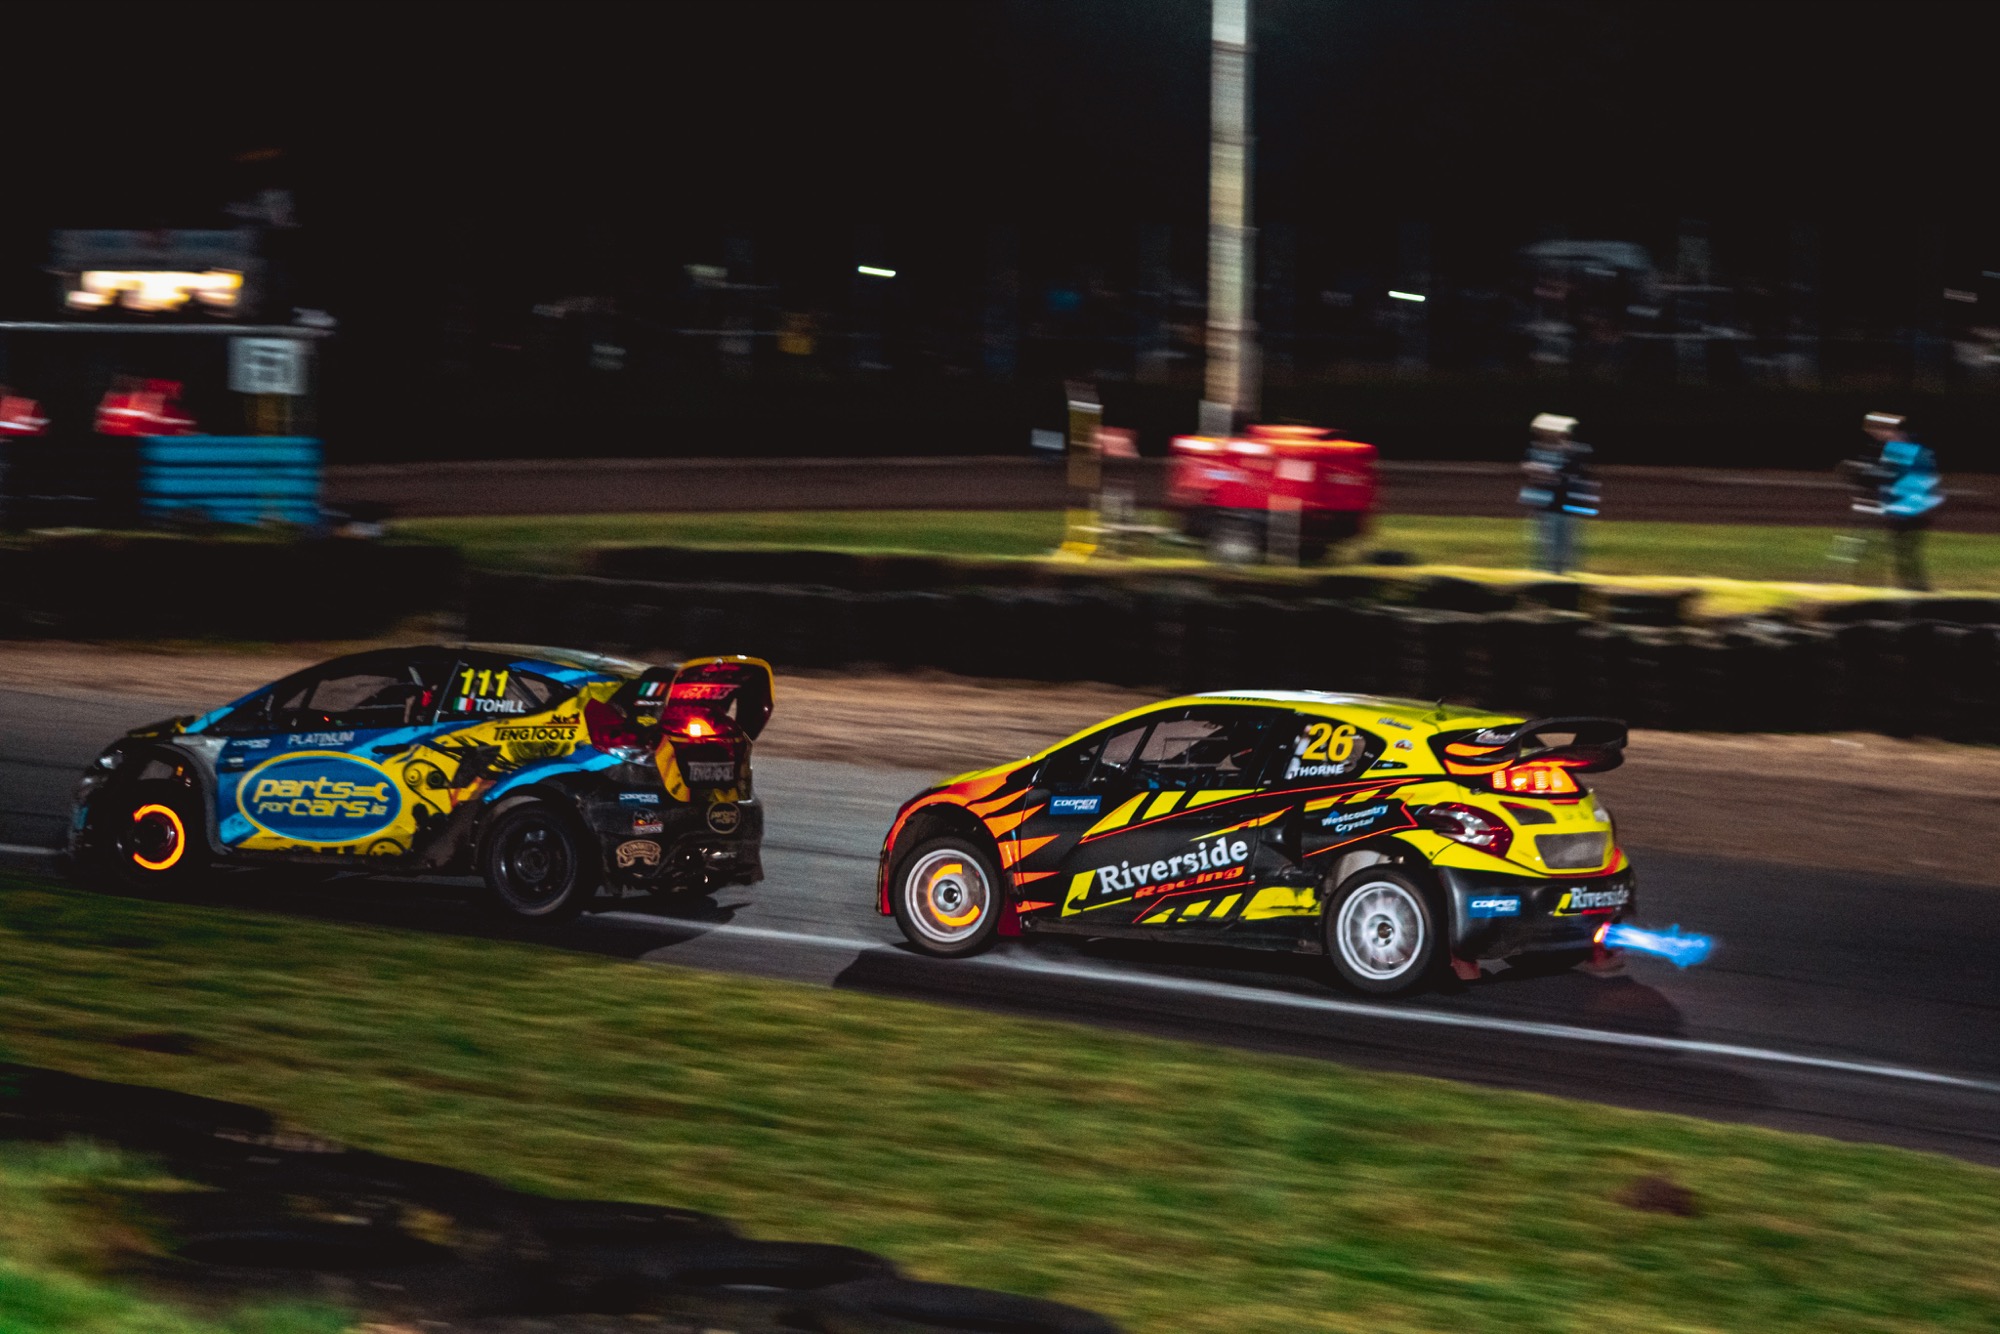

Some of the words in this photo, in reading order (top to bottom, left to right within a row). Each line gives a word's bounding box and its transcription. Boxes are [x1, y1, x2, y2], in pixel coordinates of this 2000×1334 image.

[460, 667, 509, 698] 111
[475, 699, 526, 714] TOHILL
[287, 731, 355, 747] PLATINUM
[1301, 722, 1357, 762] 26
[1292, 763, 1345, 777] THORNE
[252, 776, 356, 803] parts
[1053, 798, 1098, 808] COOPER
[1321, 804, 1389, 827] Westcountry
[1334, 817, 1375, 835] Crystal
[1097, 837, 1249, 895] Riverside
[1134, 865, 1246, 900] Racing
[1570, 884, 1629, 909] Riverside
